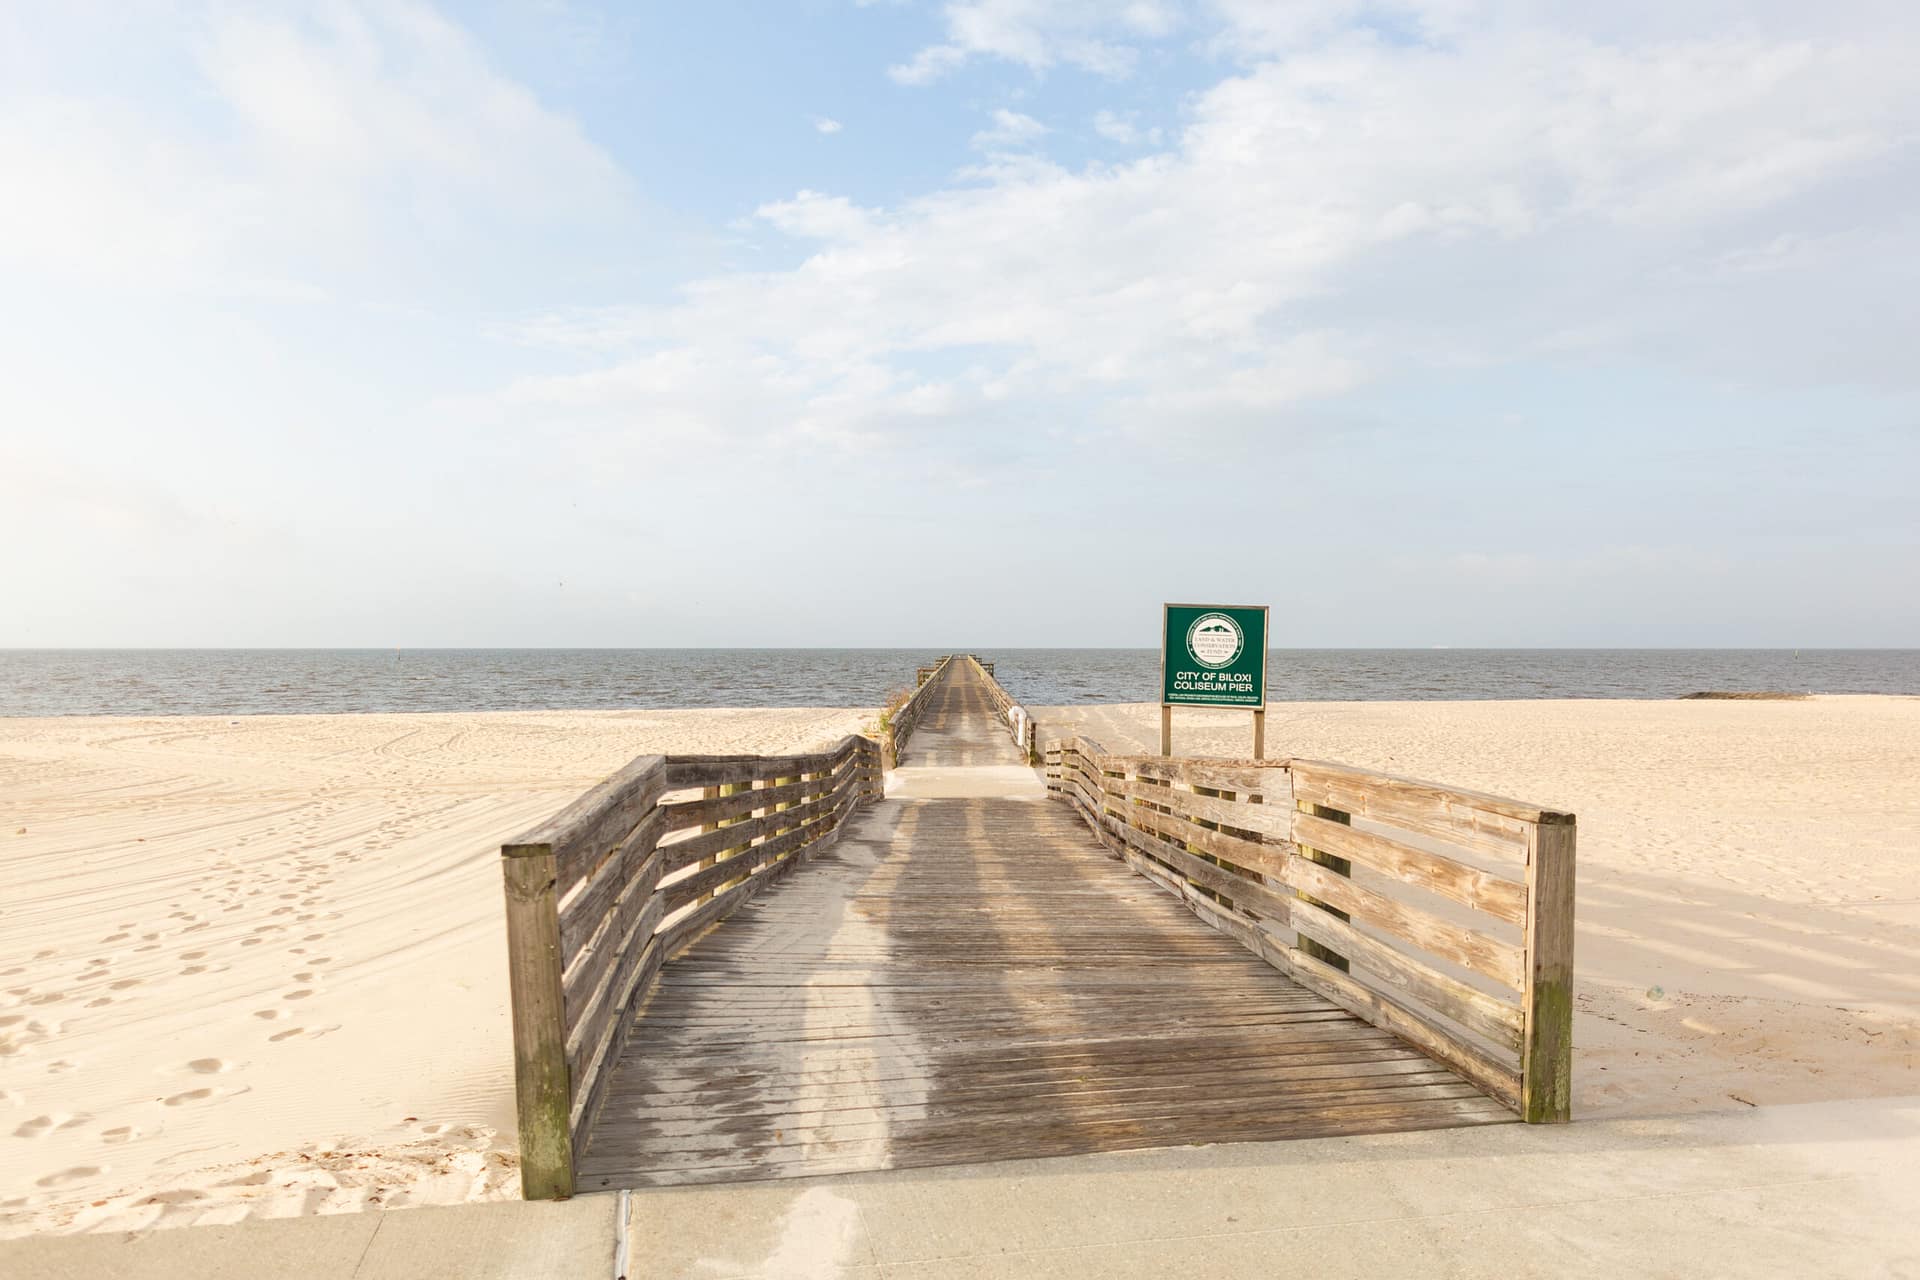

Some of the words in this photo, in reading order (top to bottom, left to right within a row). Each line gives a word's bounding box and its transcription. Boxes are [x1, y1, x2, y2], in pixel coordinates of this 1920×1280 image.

[1176, 671, 1200, 680] CITY
[1202, 672, 1217, 681] OF
[1218, 673, 1252, 682] BILOXI
[1174, 681, 1226, 691] COLISEUM
[1229, 683, 1253, 692] PIER
